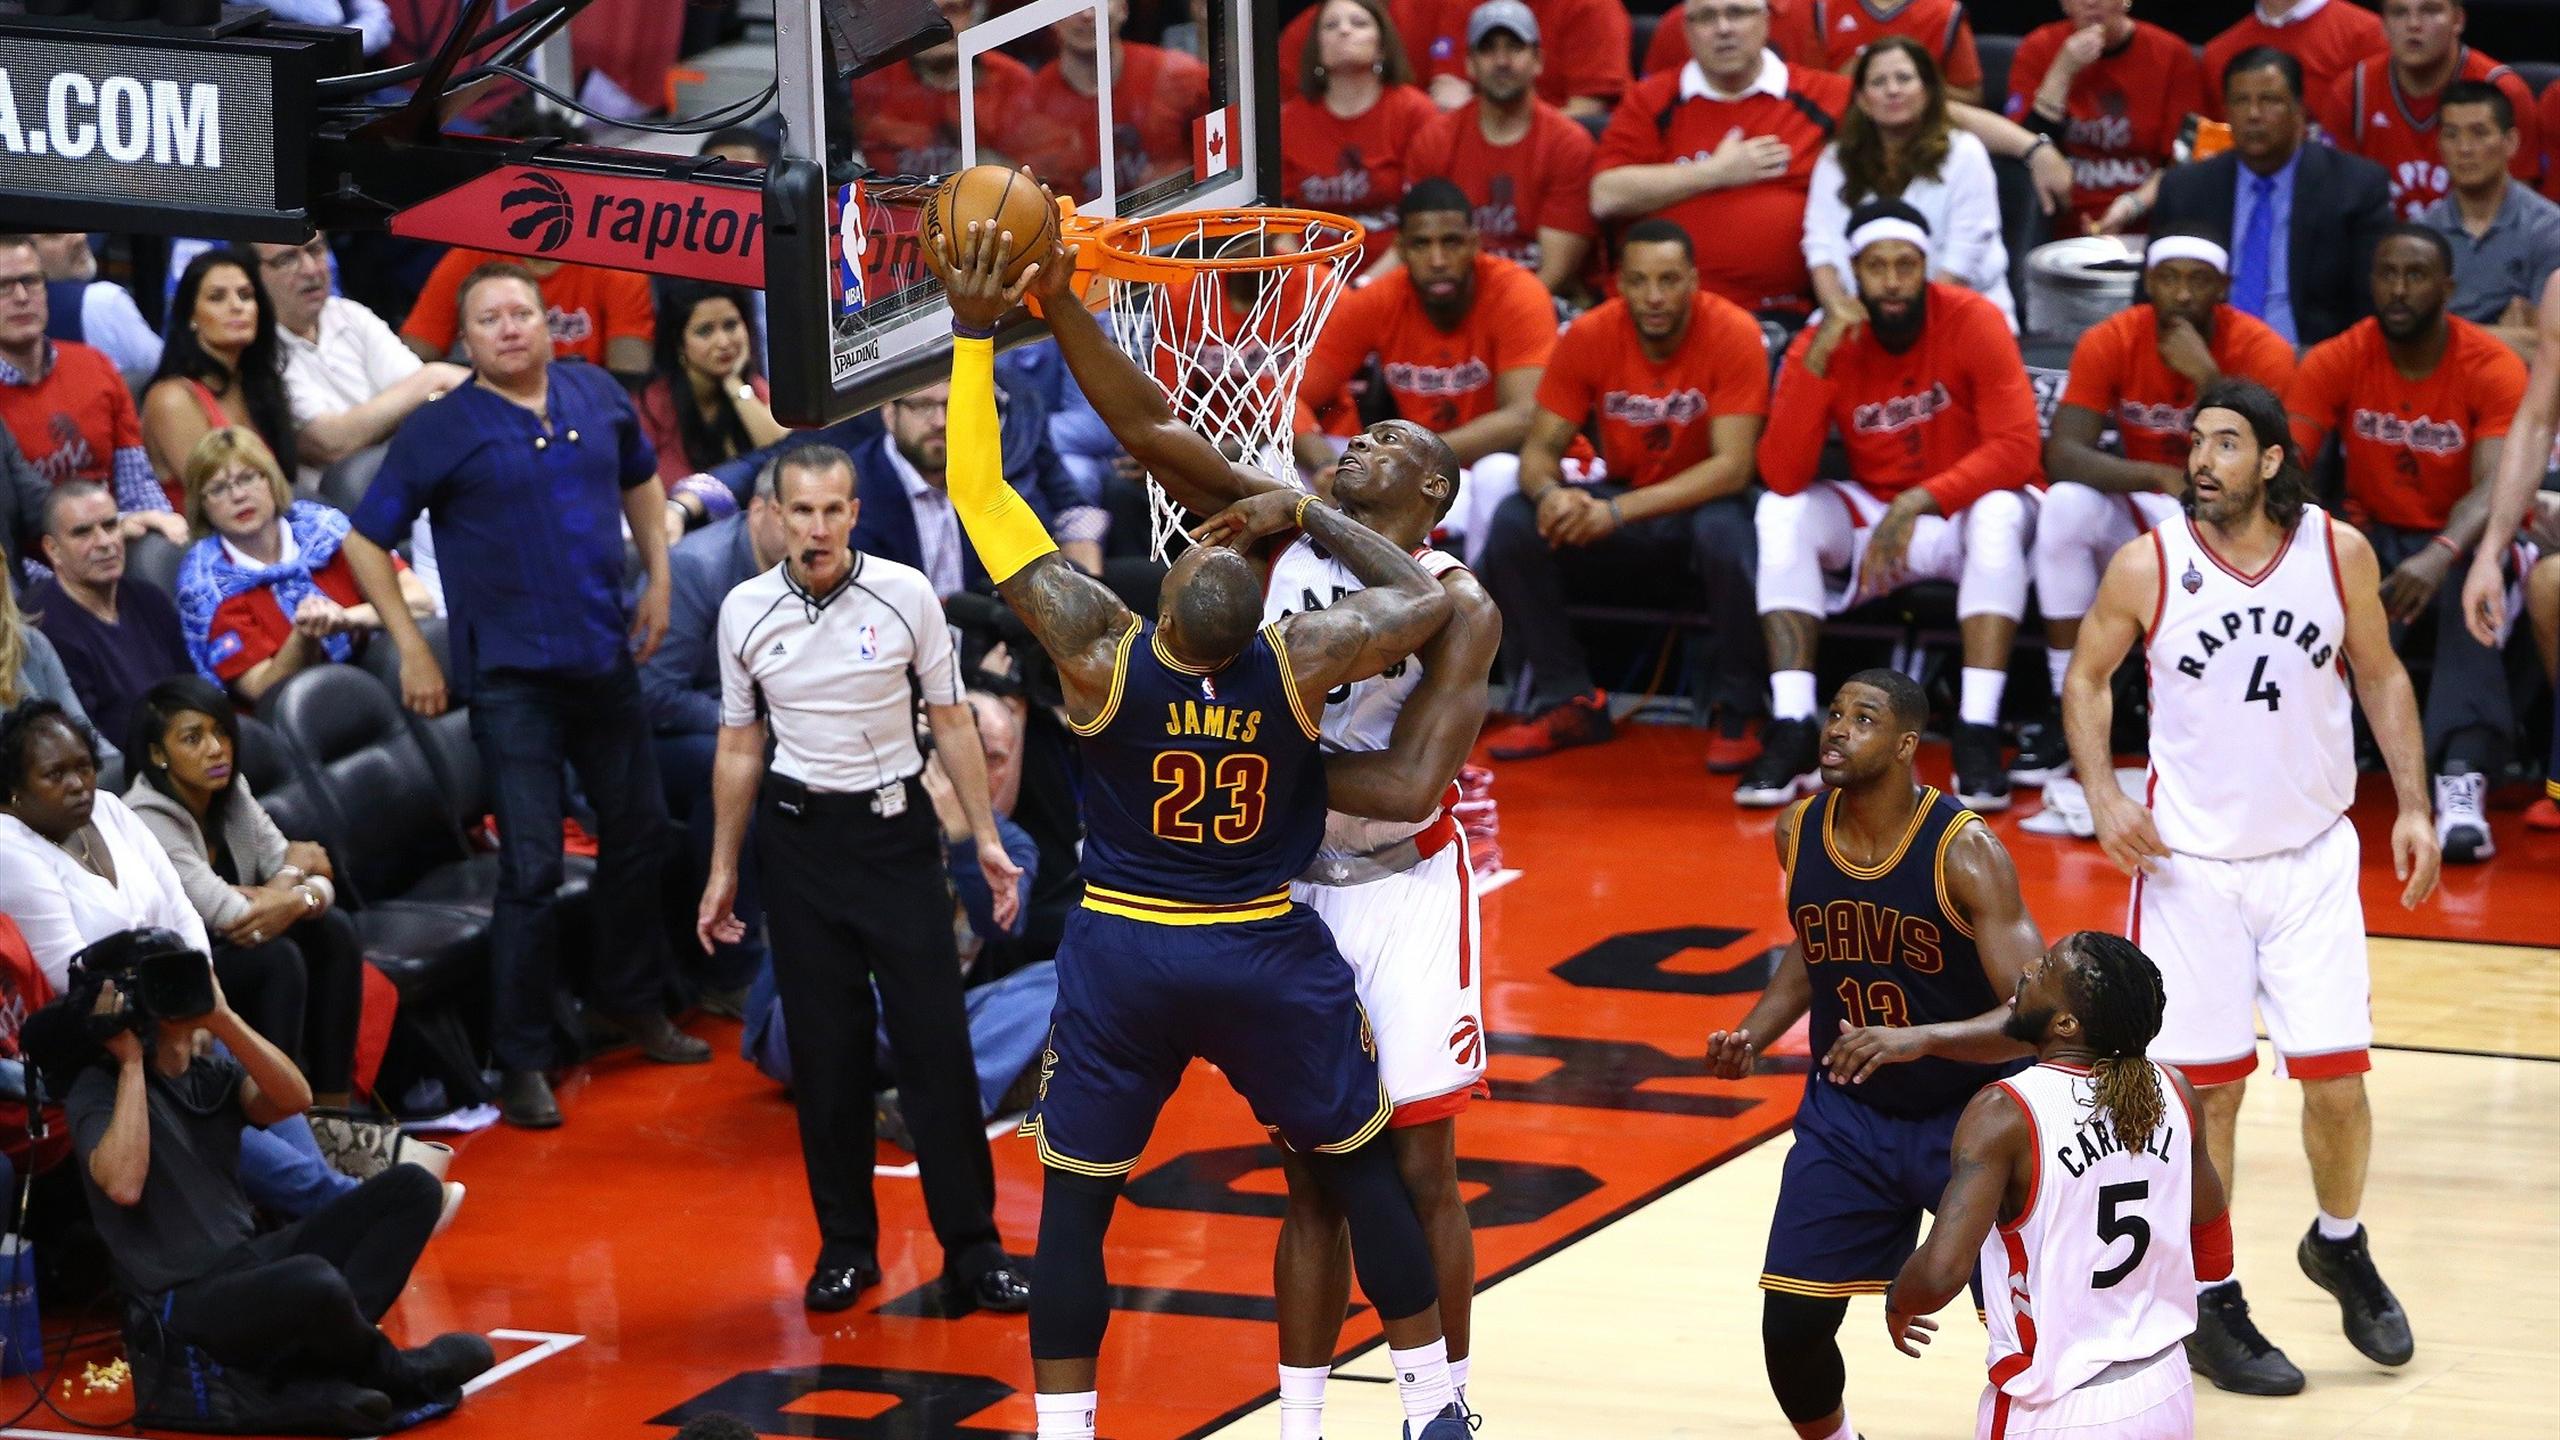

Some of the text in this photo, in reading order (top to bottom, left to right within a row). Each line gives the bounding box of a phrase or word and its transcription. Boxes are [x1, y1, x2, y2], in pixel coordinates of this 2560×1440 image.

[845, 285, 861, 307] NBA
[834, 338, 880, 376] SPALDING
[2177, 607, 2332, 680] RAPTORS
[2244, 655, 2282, 711] 4
[1165, 700, 1262, 743] JAMES
[1153, 750, 1269, 844] 23
[1795, 900, 1944, 974] CAVS
[1836, 977, 1912, 1029] 13
[2058, 1119, 2173, 1179] CARLL
[2091, 1179, 2151, 1289] 5
